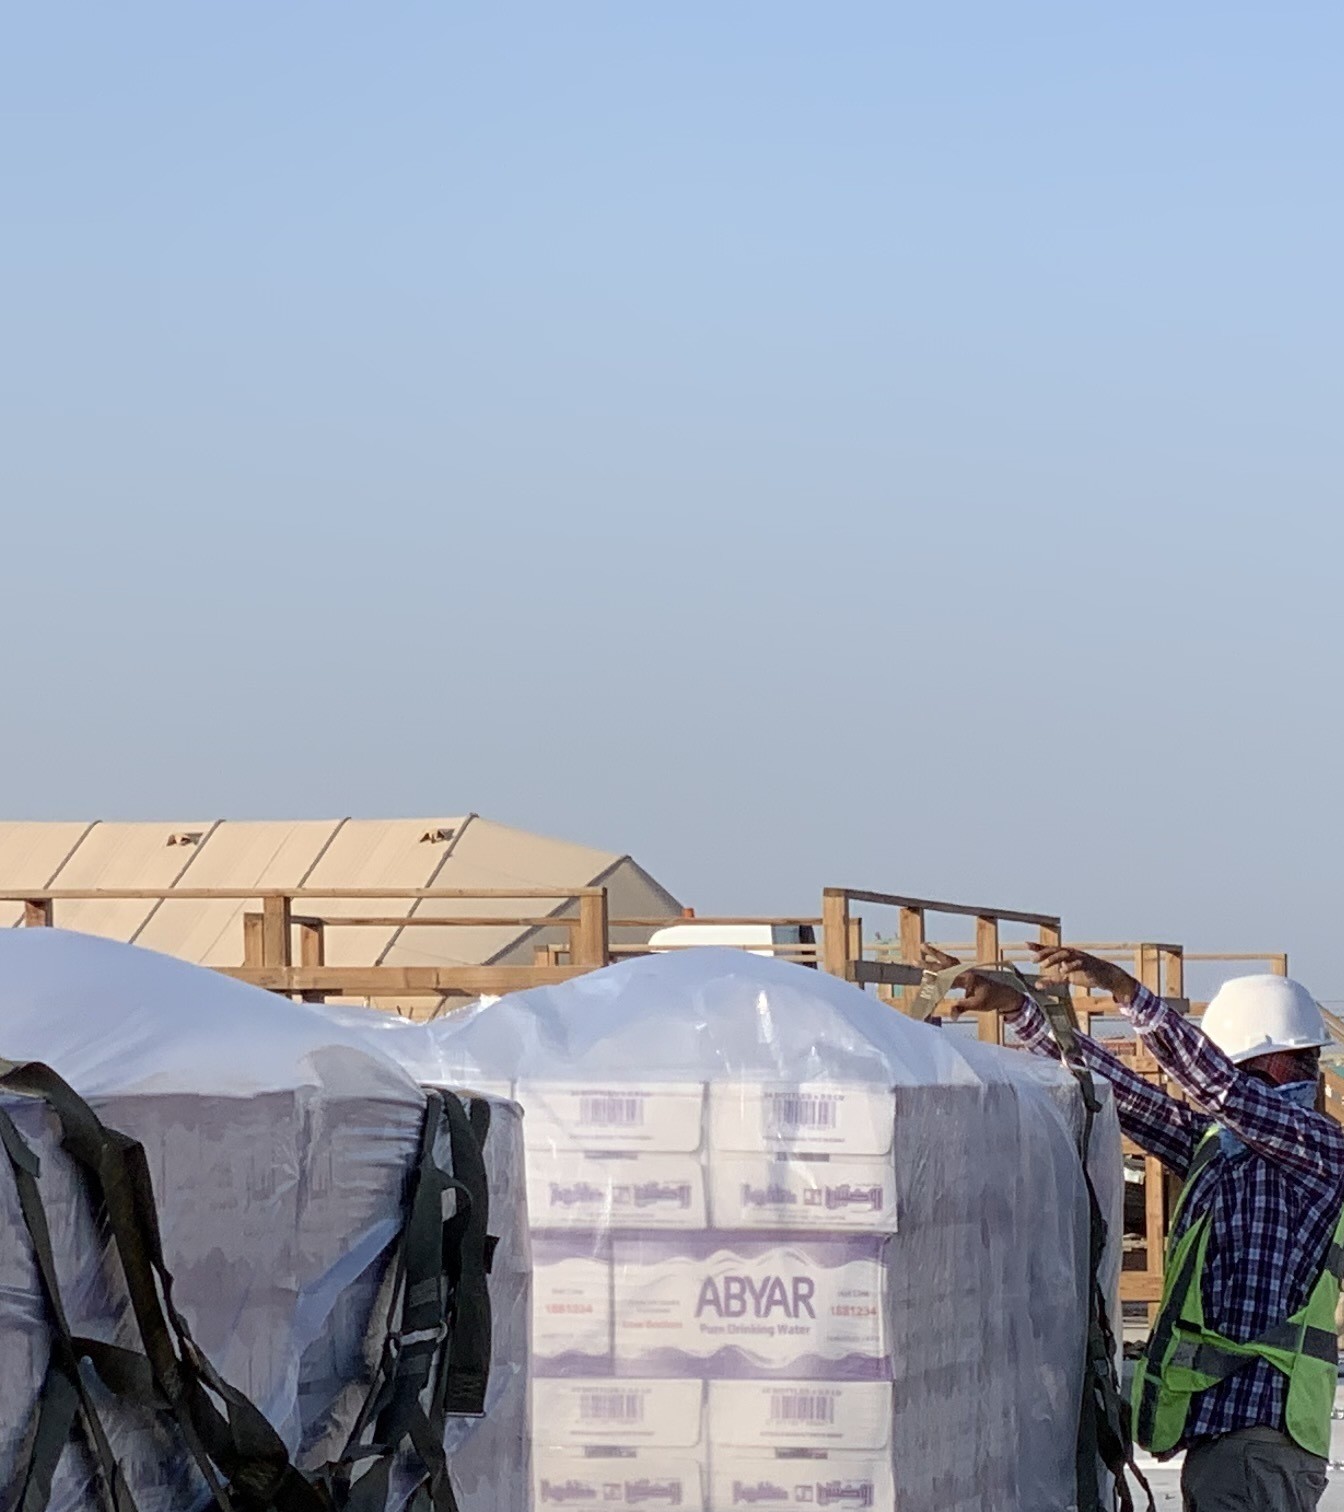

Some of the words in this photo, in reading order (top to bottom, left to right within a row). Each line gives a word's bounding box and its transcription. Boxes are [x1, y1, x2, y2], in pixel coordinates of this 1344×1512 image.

[694, 1275, 816, 1319] ABYAR
[728, 1323, 775, 1337] Drinking
[778, 1324, 811, 1335] Water
